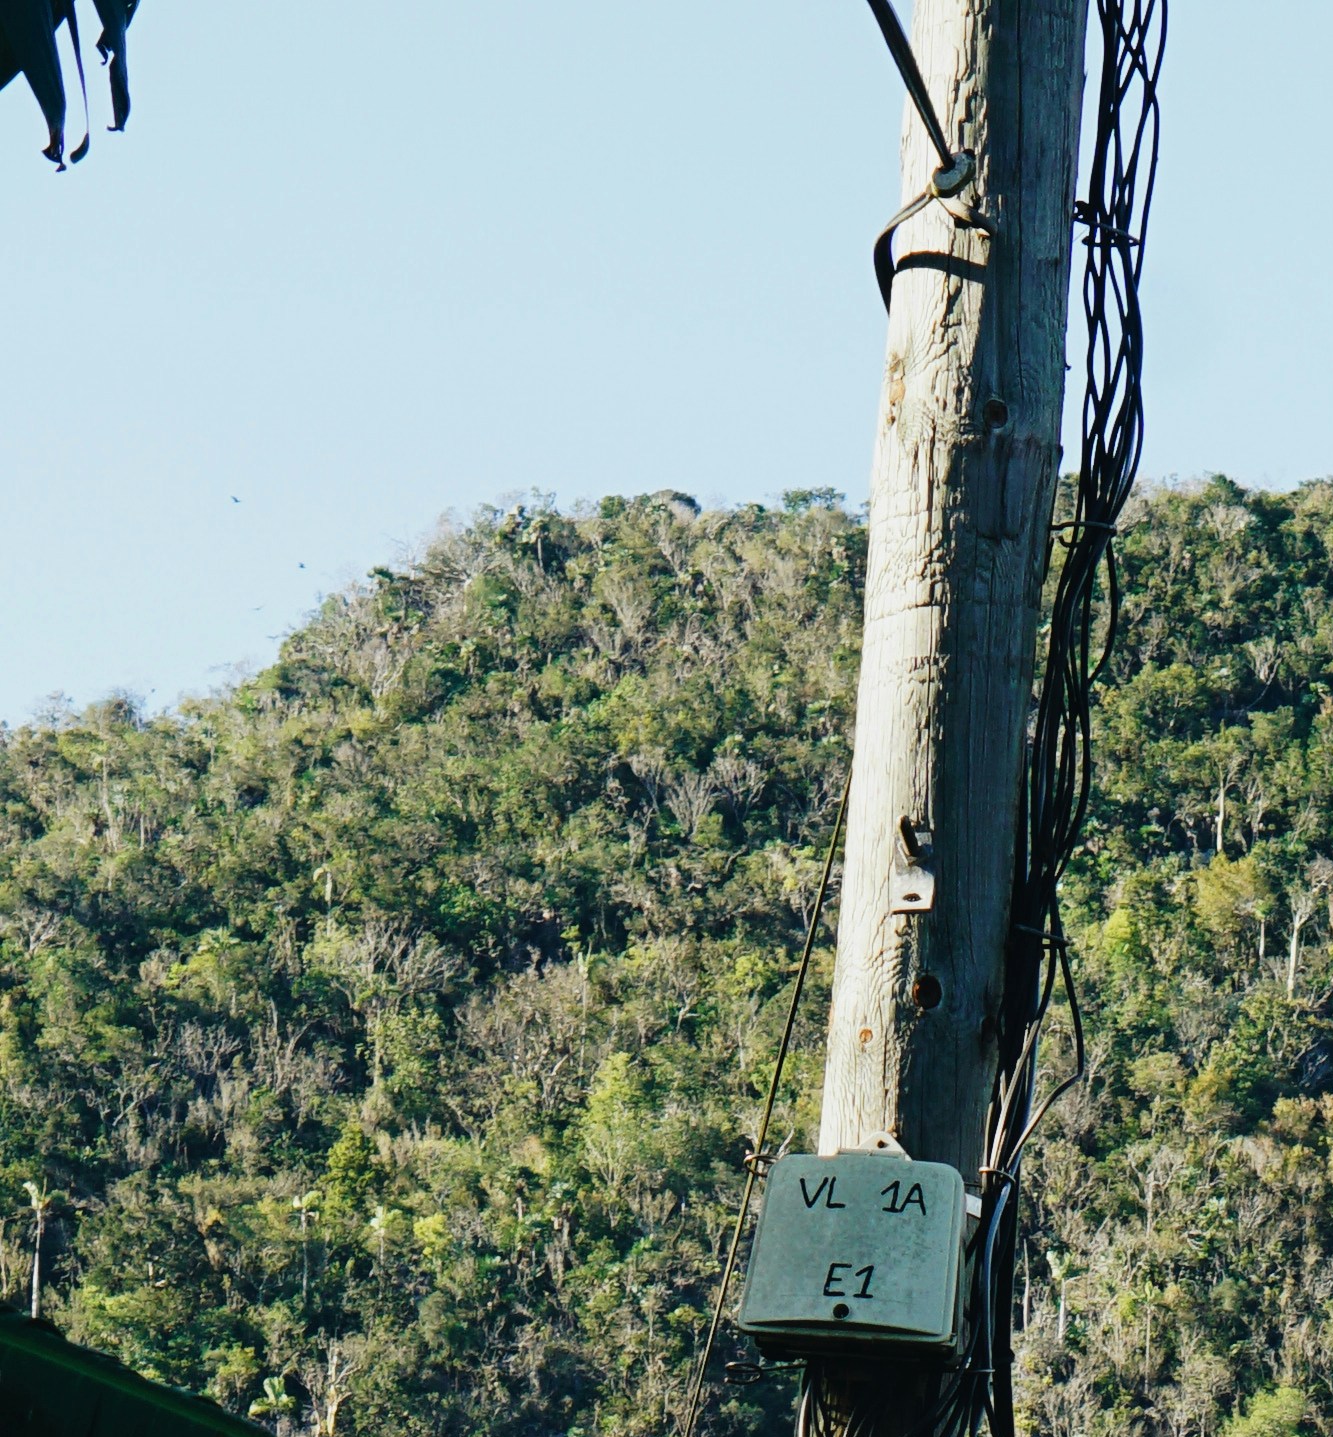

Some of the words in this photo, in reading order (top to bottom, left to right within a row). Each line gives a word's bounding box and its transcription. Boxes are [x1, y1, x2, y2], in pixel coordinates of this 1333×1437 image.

[800, 1176, 846, 1209] VL
[881, 1180, 927, 1216] 1A
[823, 1262, 875, 1299] E1
